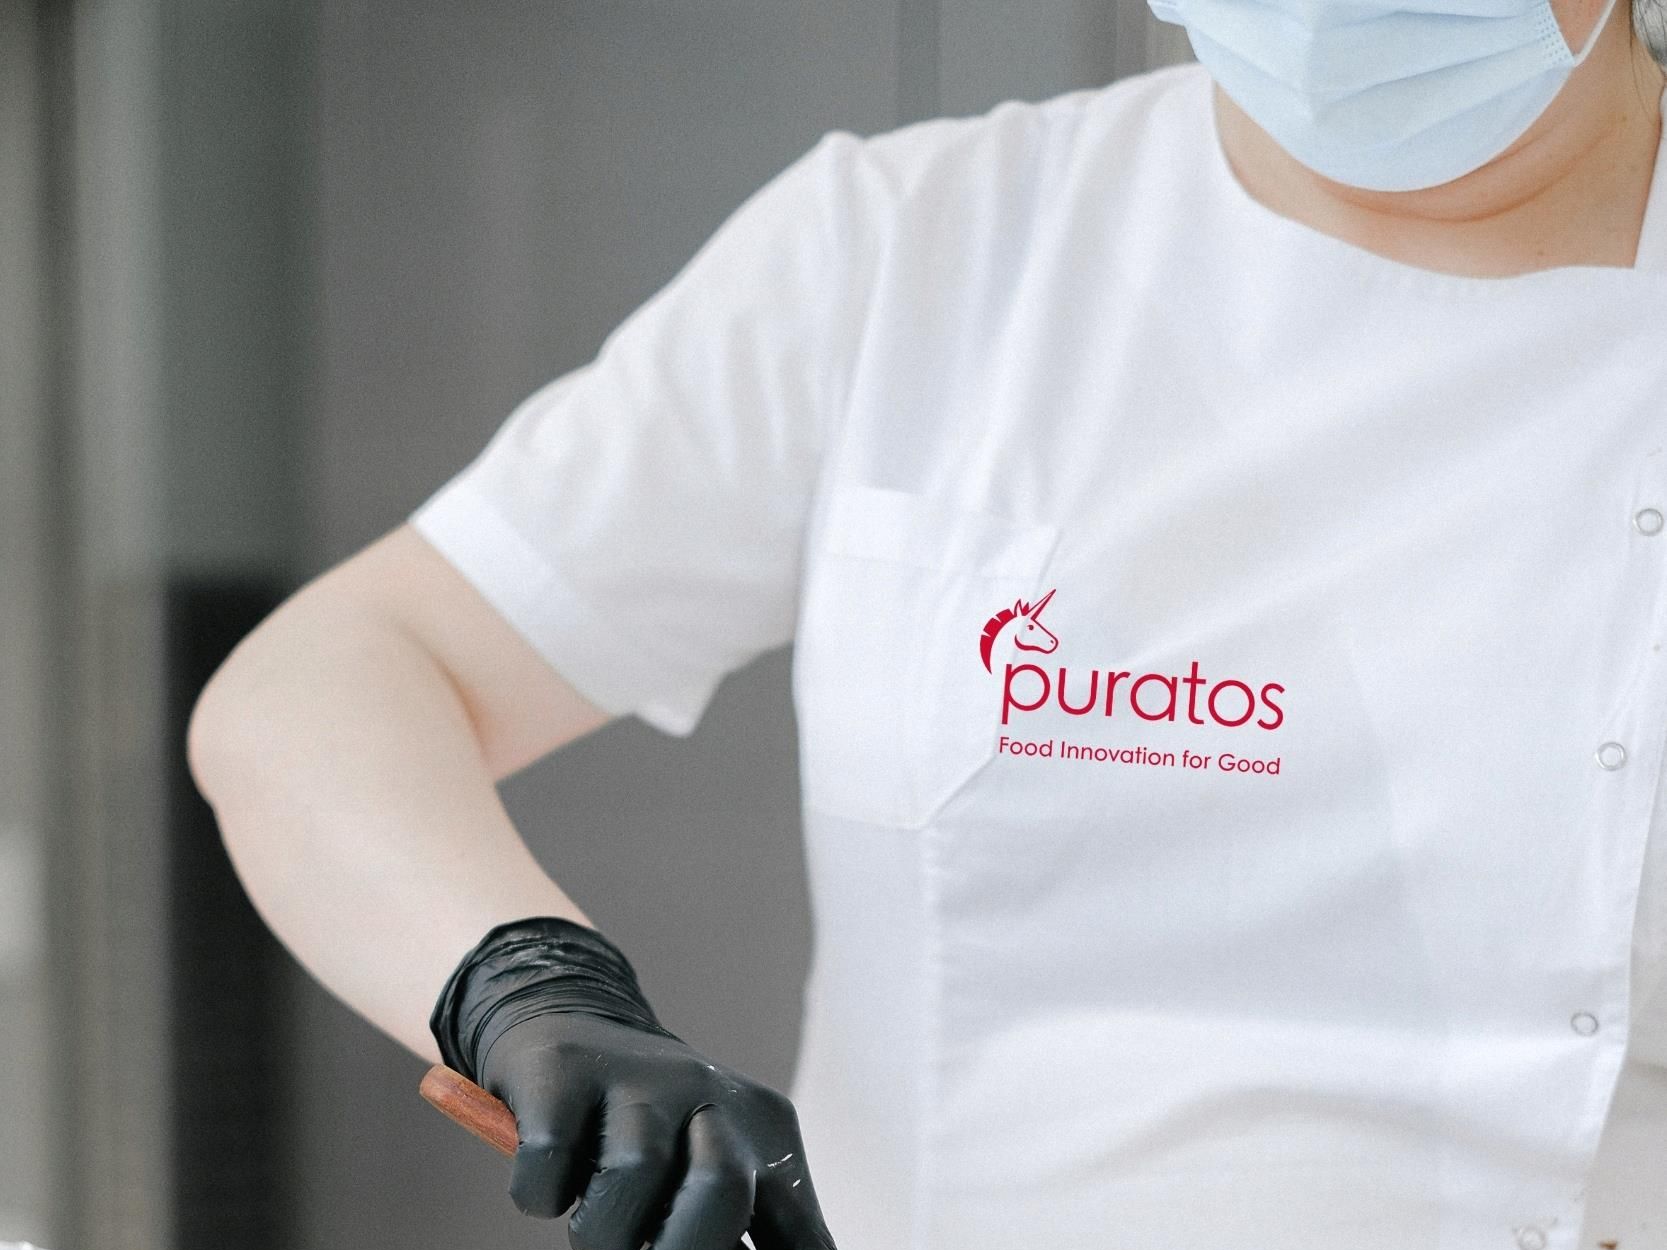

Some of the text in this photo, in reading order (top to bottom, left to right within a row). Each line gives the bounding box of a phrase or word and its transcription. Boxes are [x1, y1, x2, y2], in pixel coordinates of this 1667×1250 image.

[1001, 661, 1285, 731] puratos
[1000, 737, 1281, 775] Food Innovation for Good
